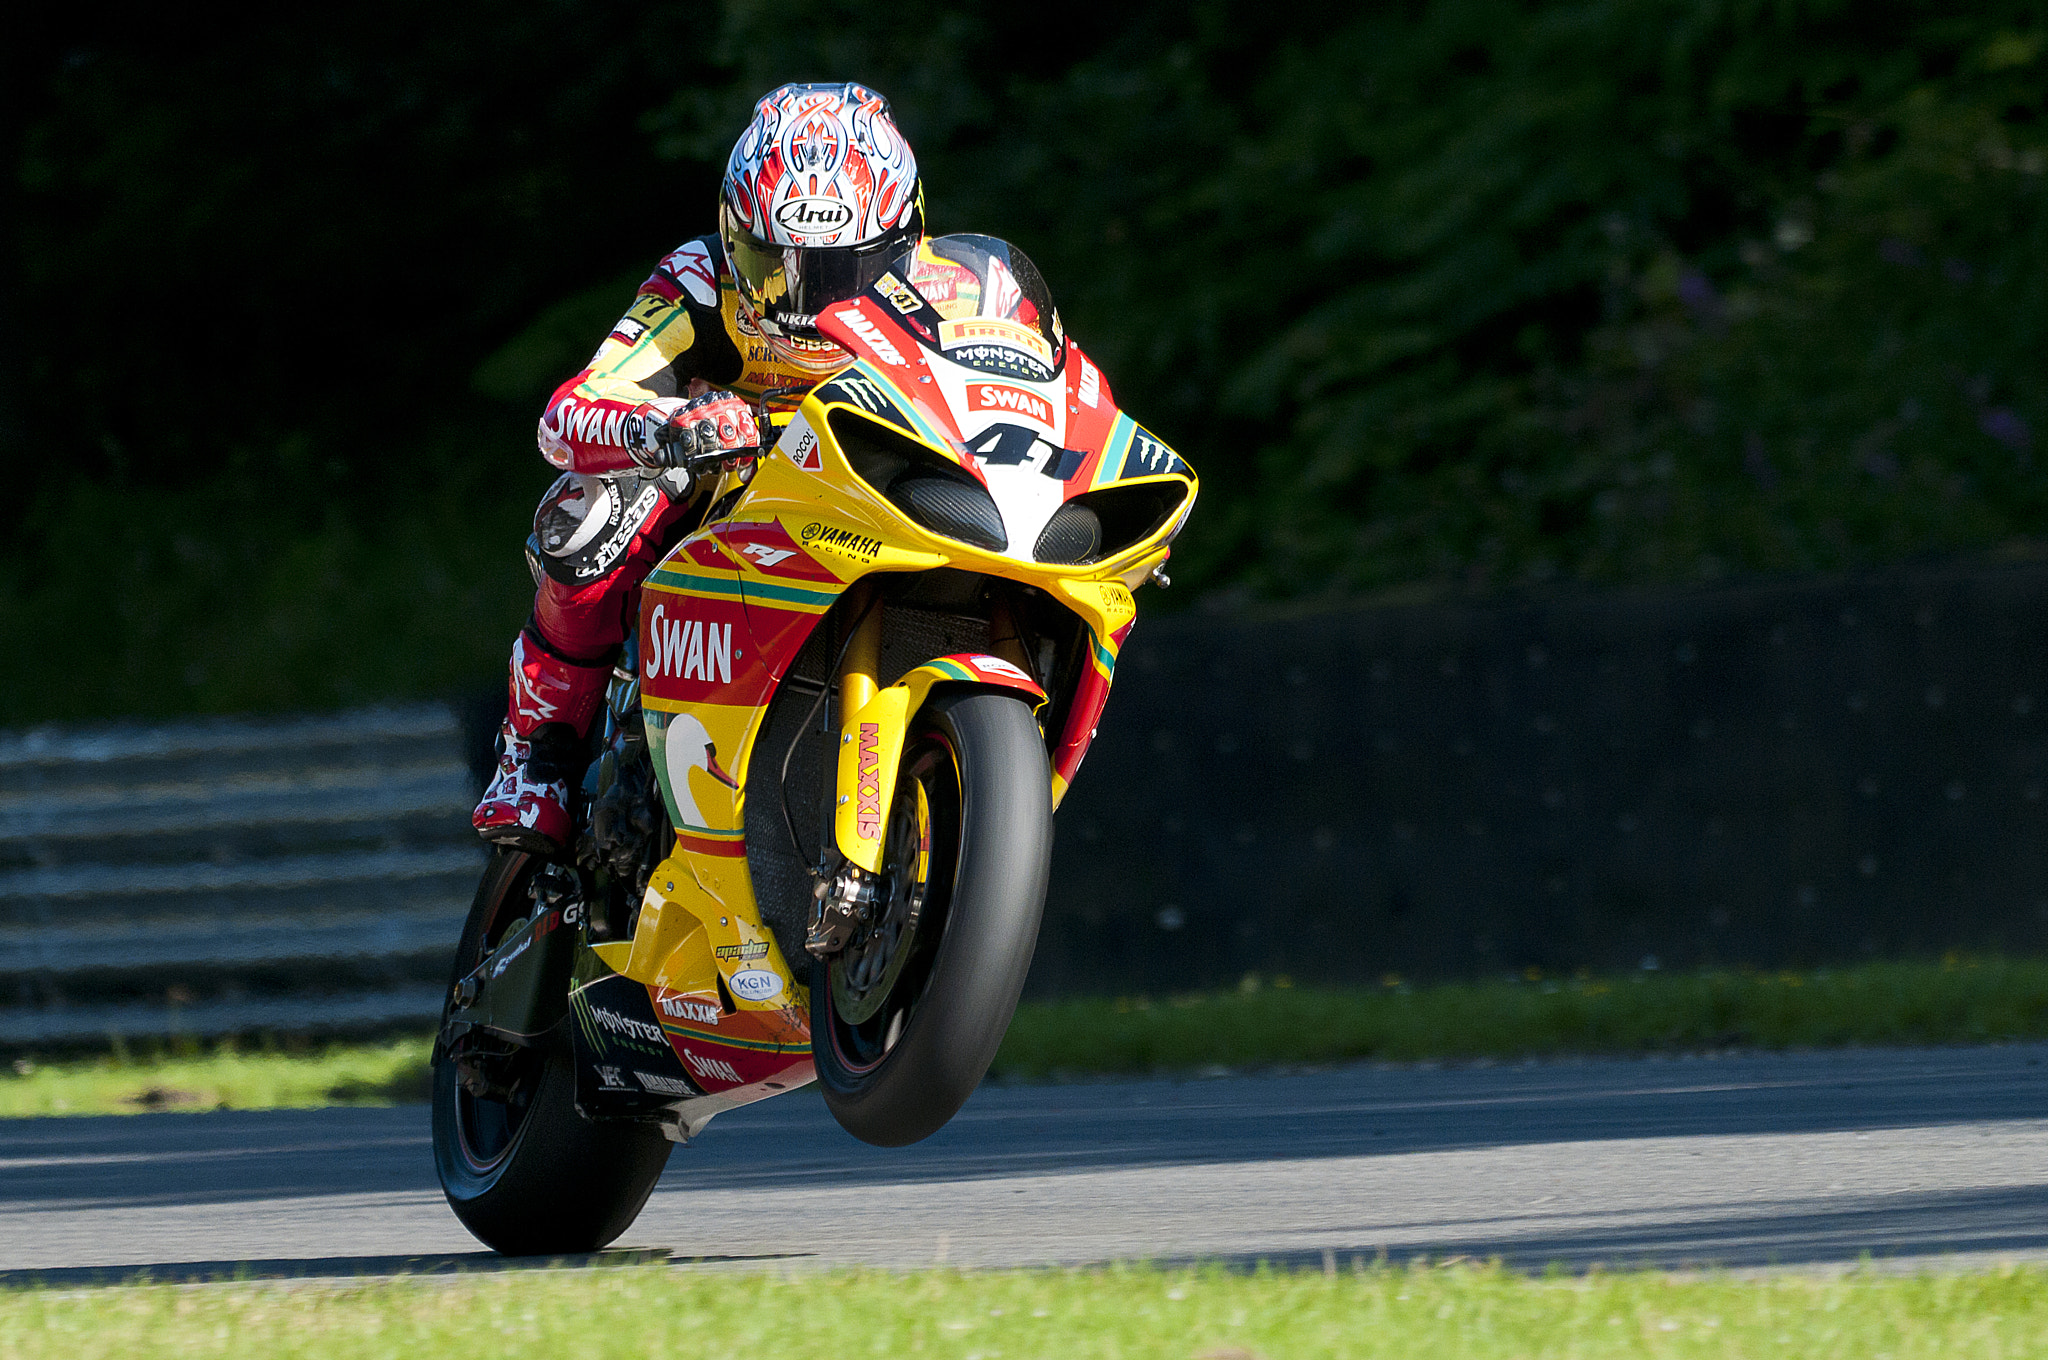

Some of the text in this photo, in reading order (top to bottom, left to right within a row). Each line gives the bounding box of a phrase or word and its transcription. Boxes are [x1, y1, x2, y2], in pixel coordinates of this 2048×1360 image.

[780, 203, 844, 223] Arai
[892, 293, 921, 311] 41
[834, 308, 907, 366] MAXXIS
[954, 322, 1044, 355] PIRELLI
[972, 359, 1040, 379] ENERGY
[980, 385, 1047, 421] SWAN
[550, 397, 628, 447] SWAN
[792, 431, 815, 465] ROCOL
[609, 484, 622, 526] RACING
[801, 540, 871, 565] RACING
[818, 525, 883, 558] YAMAHA
[646, 604, 732, 684] SWAN
[857, 722, 882, 841] MAXXIS
[737, 975, 772, 989] KGN
[661, 997, 719, 1026] MAXXIS
[684, 1047, 745, 1083] SWAN
